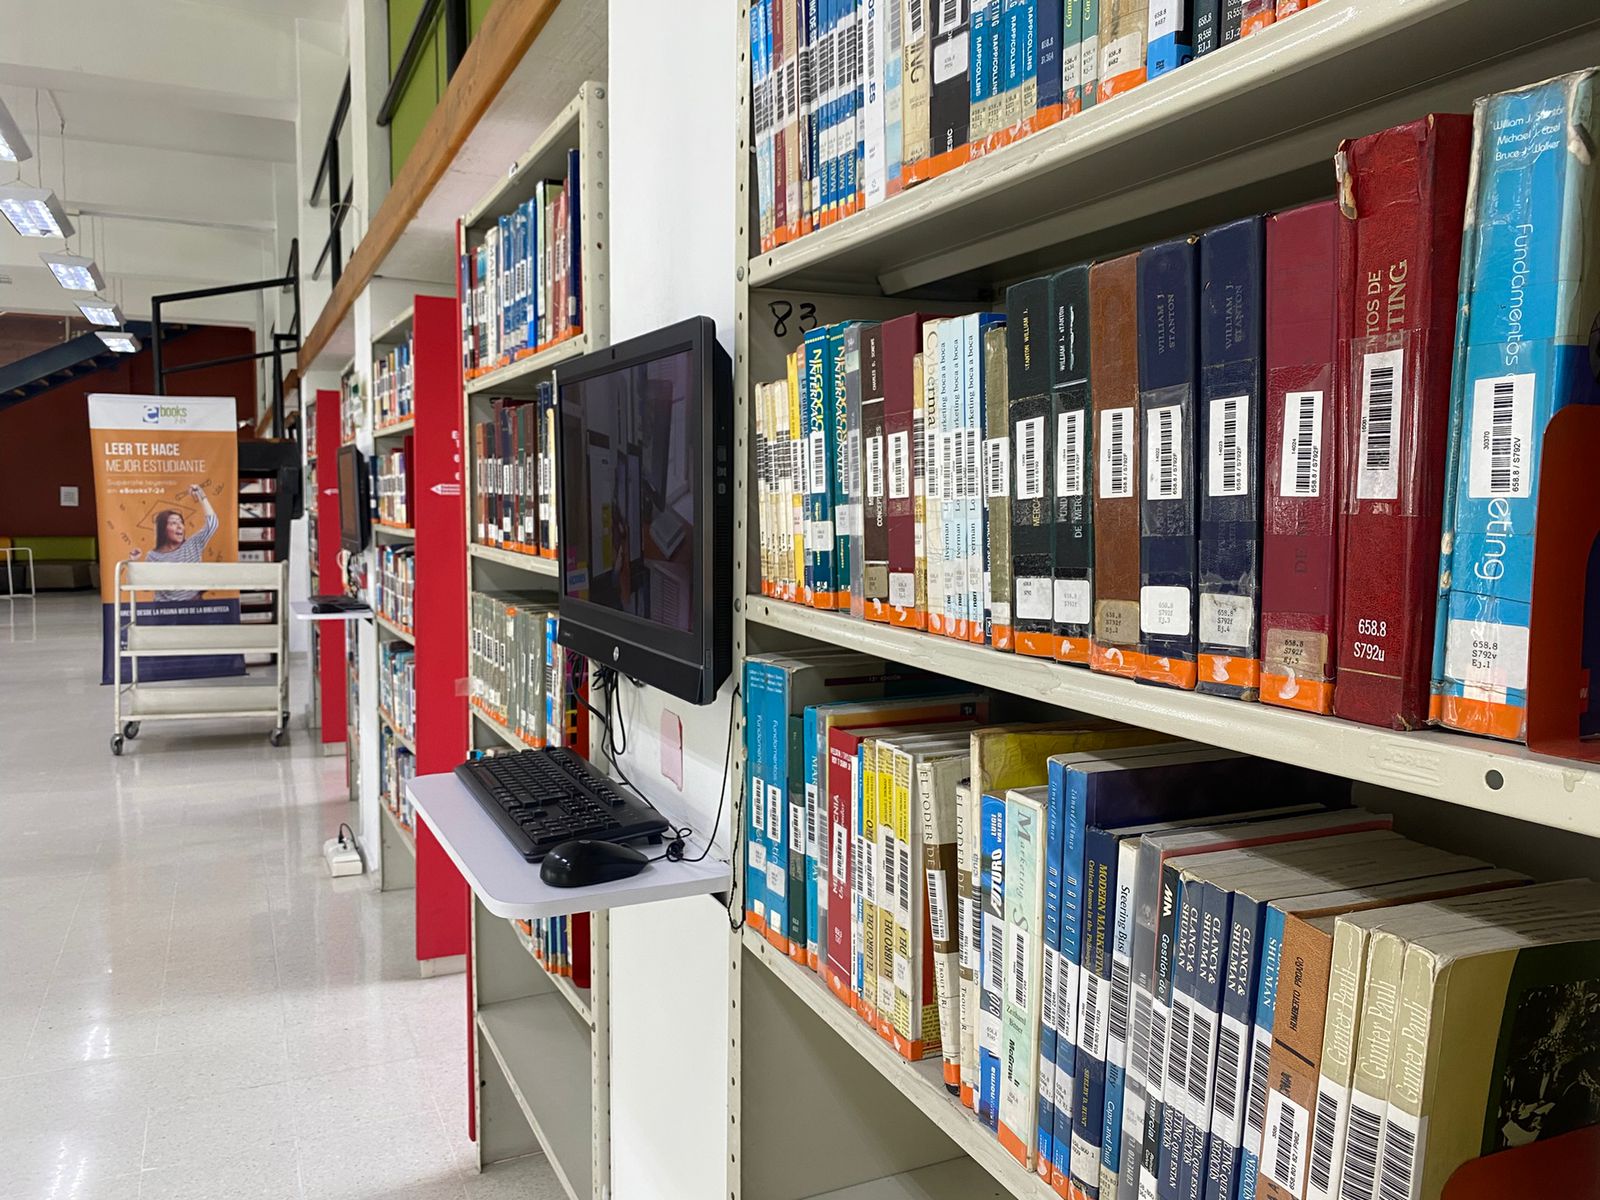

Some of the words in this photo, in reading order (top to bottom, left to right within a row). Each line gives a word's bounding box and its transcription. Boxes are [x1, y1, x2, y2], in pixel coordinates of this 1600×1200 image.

[808, 19, 817, 32] DE
[1026, 6, 1034, 71] RAPP/COLLINS
[1009, 15, 1017, 79] RAPP/COLLINS
[975, 36, 983, 97] RAPP/COLLINS
[1493, 116, 1524, 131] William
[1495, 149, 1520, 162] Bruce
[1532, 140, 1560, 154] Walker
[1496, 131, 1532, 146] Michael
[1367, 269, 1381, 295] DE
[1505, 223, 1534, 367] Fundamentos
[768, 300, 818, 338] 83
[1167, 293, 1176, 349] STANTON
[1225, 297, 1233, 350] WILLIAM
[1234, 284, 1244, 343] STANTON
[1157, 305, 1165, 355] WILLIAM
[105, 443, 133, 456] LEER
[135, 443, 149, 456] TE
[151, 444, 180, 456] HACE
[1513, 436, 1522, 463] S792V
[105, 459, 141, 473] MEJOR
[143, 459, 206, 473] ESTUDIANTE
[1075, 526, 1083, 538] DE
[1473, 498, 1513, 580] eting
[137, 609, 153, 617] DESDE
[1358, 618, 1387, 638] 658.8
[1284, 639, 1304, 648] 658.8
[1353, 641, 1385, 662] S792u
[1472, 639, 1498, 651] 658.8
[1472, 649, 1497, 660] S792v
[1471, 659, 1491, 669] Ej.1
[920, 771, 928, 784] EL
[956, 793, 963, 806] EL
[922, 792, 934, 840] PODER
[956, 816, 964, 865] PODER
[1015, 809, 1032, 898] Marketing
[926, 847, 936, 866] DE
[957, 872, 965, 891] DE
[1088, 859, 1096, 888] Critical
[1097, 863, 1108, 911] MODERN
[867, 913, 875, 929] DEL
[1116, 884, 1131, 931] Steering
[884, 919, 893, 938] DEL
[1178, 903, 1190, 968] SHULMAN
[1187, 907, 1199, 963] CLANCY
[866, 930, 875, 960] LIBRO
[884, 939, 893, 967] LIBRO
[899, 937, 907, 958] DEL
[1159, 933, 1171, 978] Gestión
[1199, 911, 1212, 980] SHULMAN
[1209, 917, 1222, 974] CLANCY
[1228, 922, 1242, 992] SHULMAN
[1238, 927, 1251, 986] CLANCY
[884, 967, 893, 980] EL
[1186, 962, 1194, 973] &
[1207, 973, 1216, 984] &
[1263, 937, 1277, 1008] SHULMAN
[1158, 979, 1167, 994] de
[1237, 985, 1246, 996] &
[1332, 964, 1356, 1010] Pauli
[1367, 978, 1397, 1023] Pauli
[1289, 989, 1301, 1032] HUMBERTO
[1401, 998, 1428, 1043] Pauli
[1007, 1038, 1016, 1083] McGraw
[1106, 1100, 1115, 1127] Capra
[1148, 1097, 1156, 1143] mercial
[1163, 1105, 1174, 1150] NEGOCIOS
[1171, 1142, 1179, 1161] QUE
[1183, 1120, 1195, 1166] NEGOCIOS
[1191, 1158, 1200, 1177] QUE
[1209, 1136, 1222, 1183] NEGOCIOS
[1219, 1174, 1229, 1192] QUE
